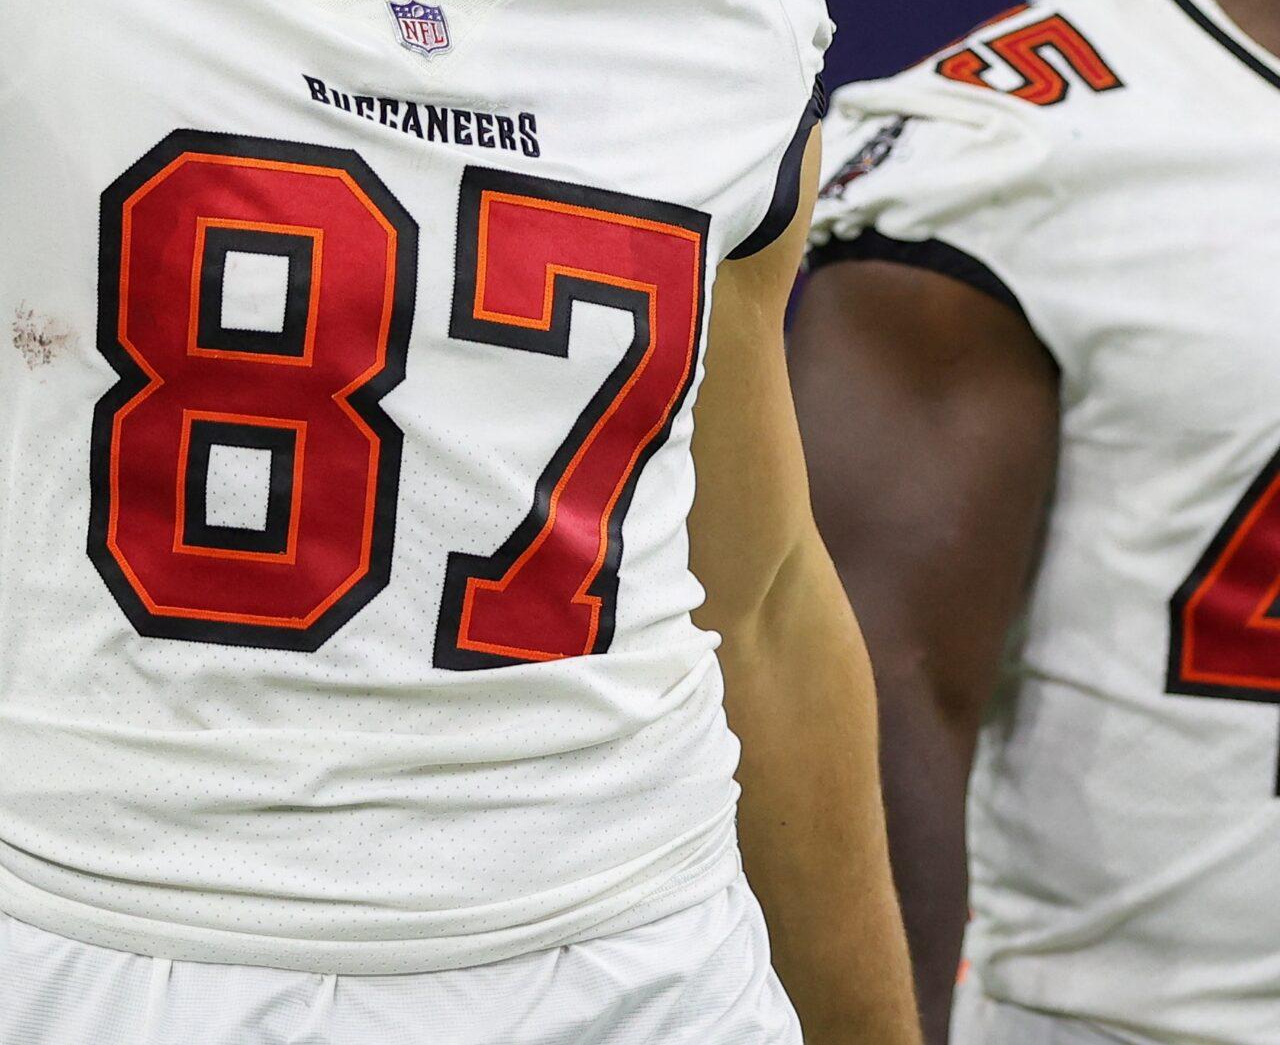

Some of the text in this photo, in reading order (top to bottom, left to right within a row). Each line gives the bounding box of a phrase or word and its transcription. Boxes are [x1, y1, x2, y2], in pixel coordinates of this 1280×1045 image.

[402, 19, 445, 45] NFL
[302, 73, 541, 158] BUCCANEERS
[86, 128, 712, 671] 87
